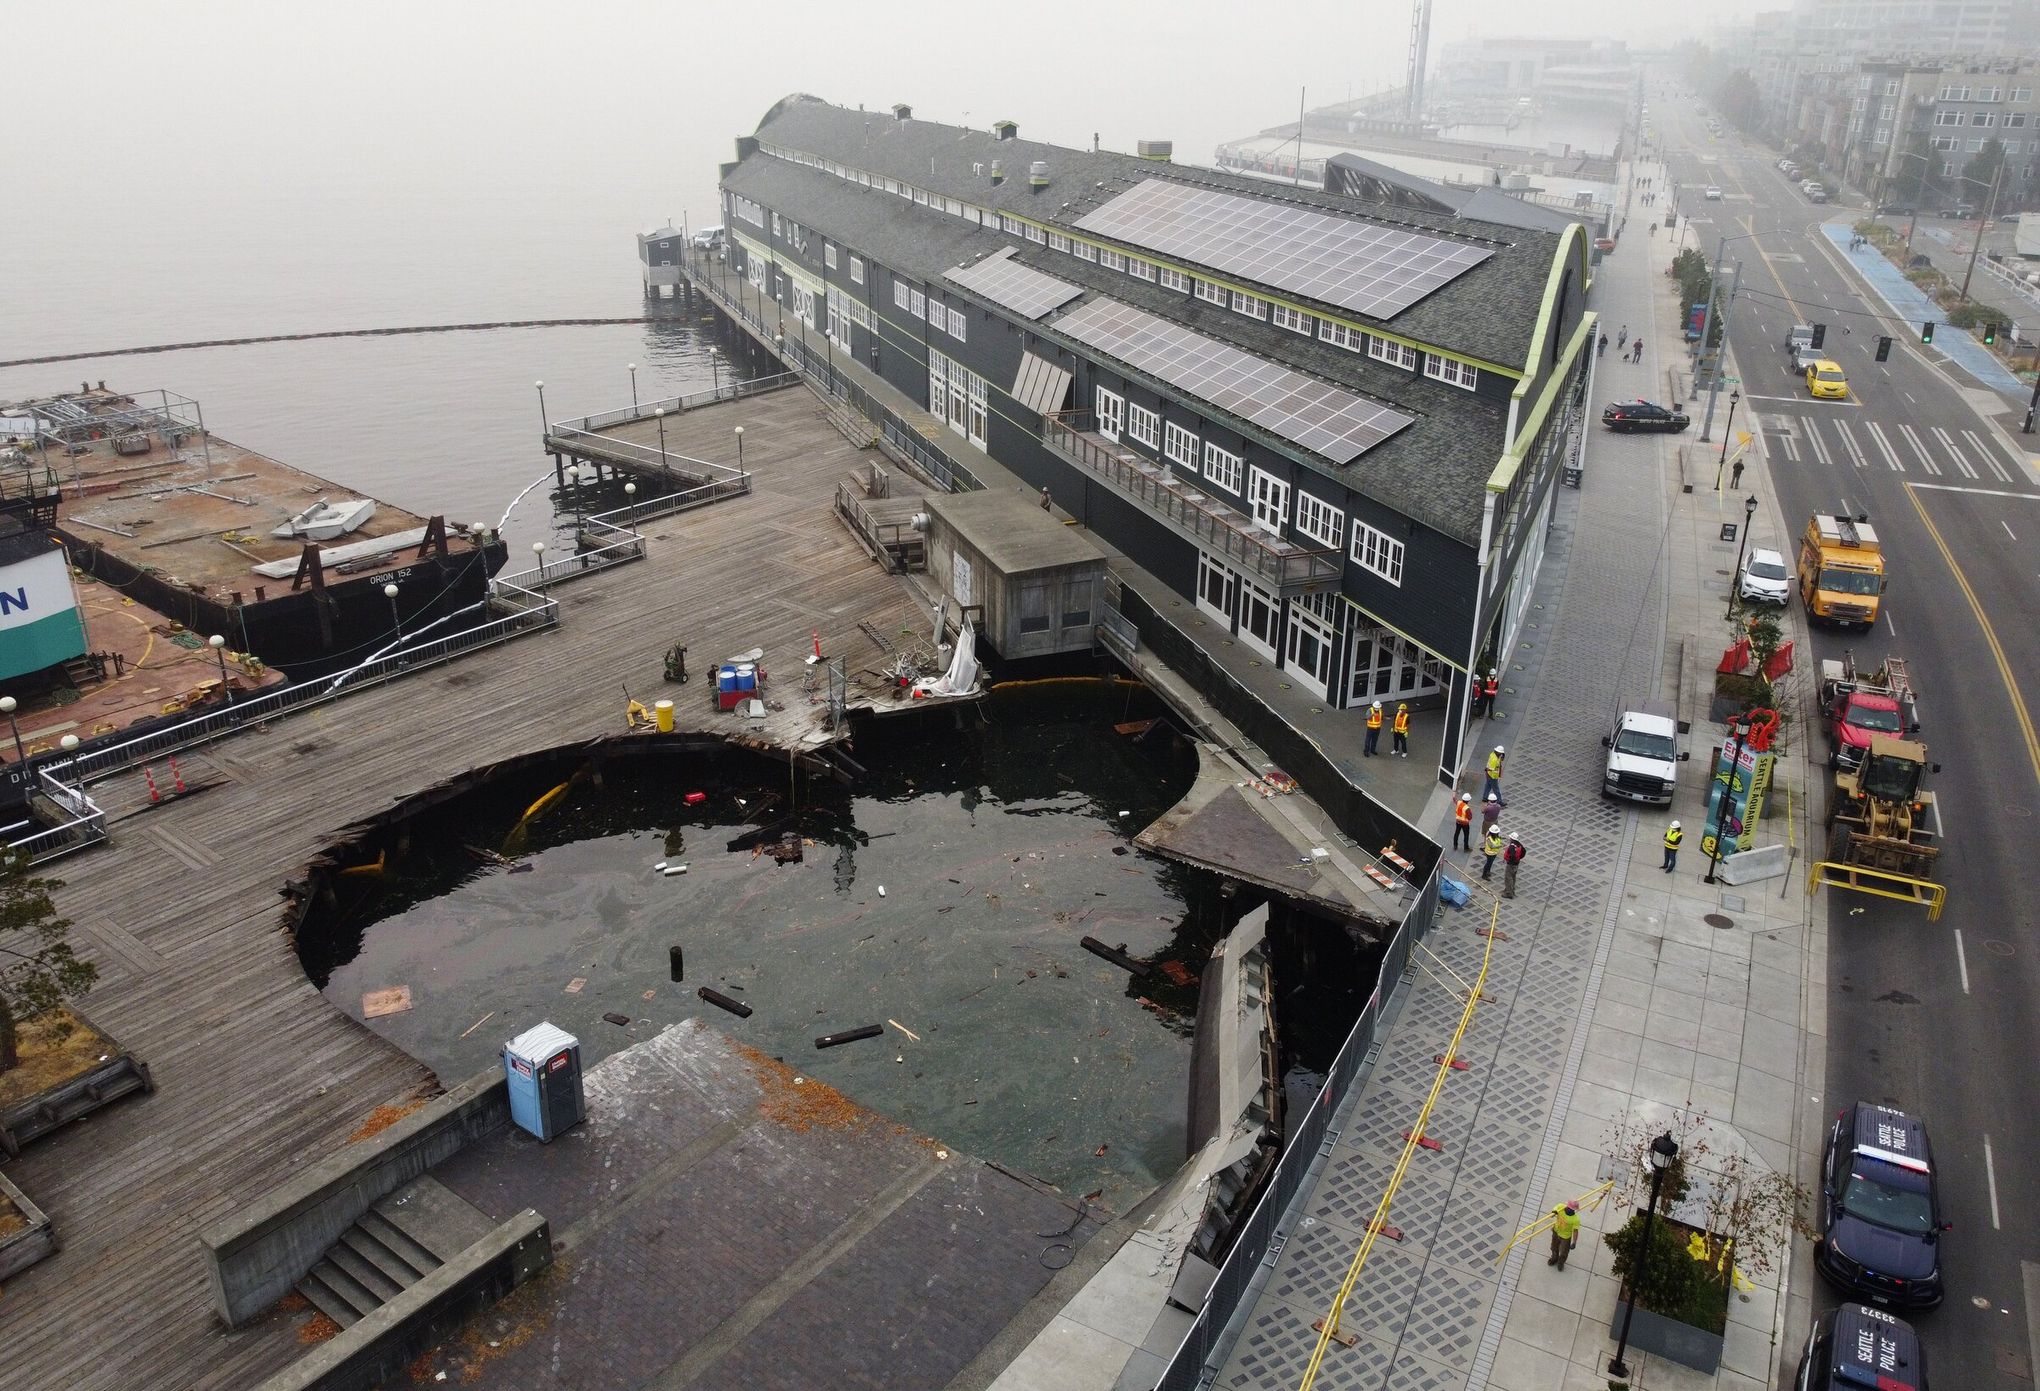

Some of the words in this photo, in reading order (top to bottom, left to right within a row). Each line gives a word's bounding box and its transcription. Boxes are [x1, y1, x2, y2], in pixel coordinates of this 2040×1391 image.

[370, 572, 394, 585] ORION
[398, 567, 412, 578] 152
[0, 587, 29, 615] N
[1753, 757, 1768, 793] SEATTLE
[1742, 793, 1760, 836] AQUARIUM
[1878, 1123, 1892, 1147] SEATTLE
[1892, 1127, 1906, 1151] POLICE
[1861, 1306, 1895, 1324] 33373
[1858, 1329, 1874, 1363] SEATTLE
[1880, 1337, 1896, 1372] POLICE
